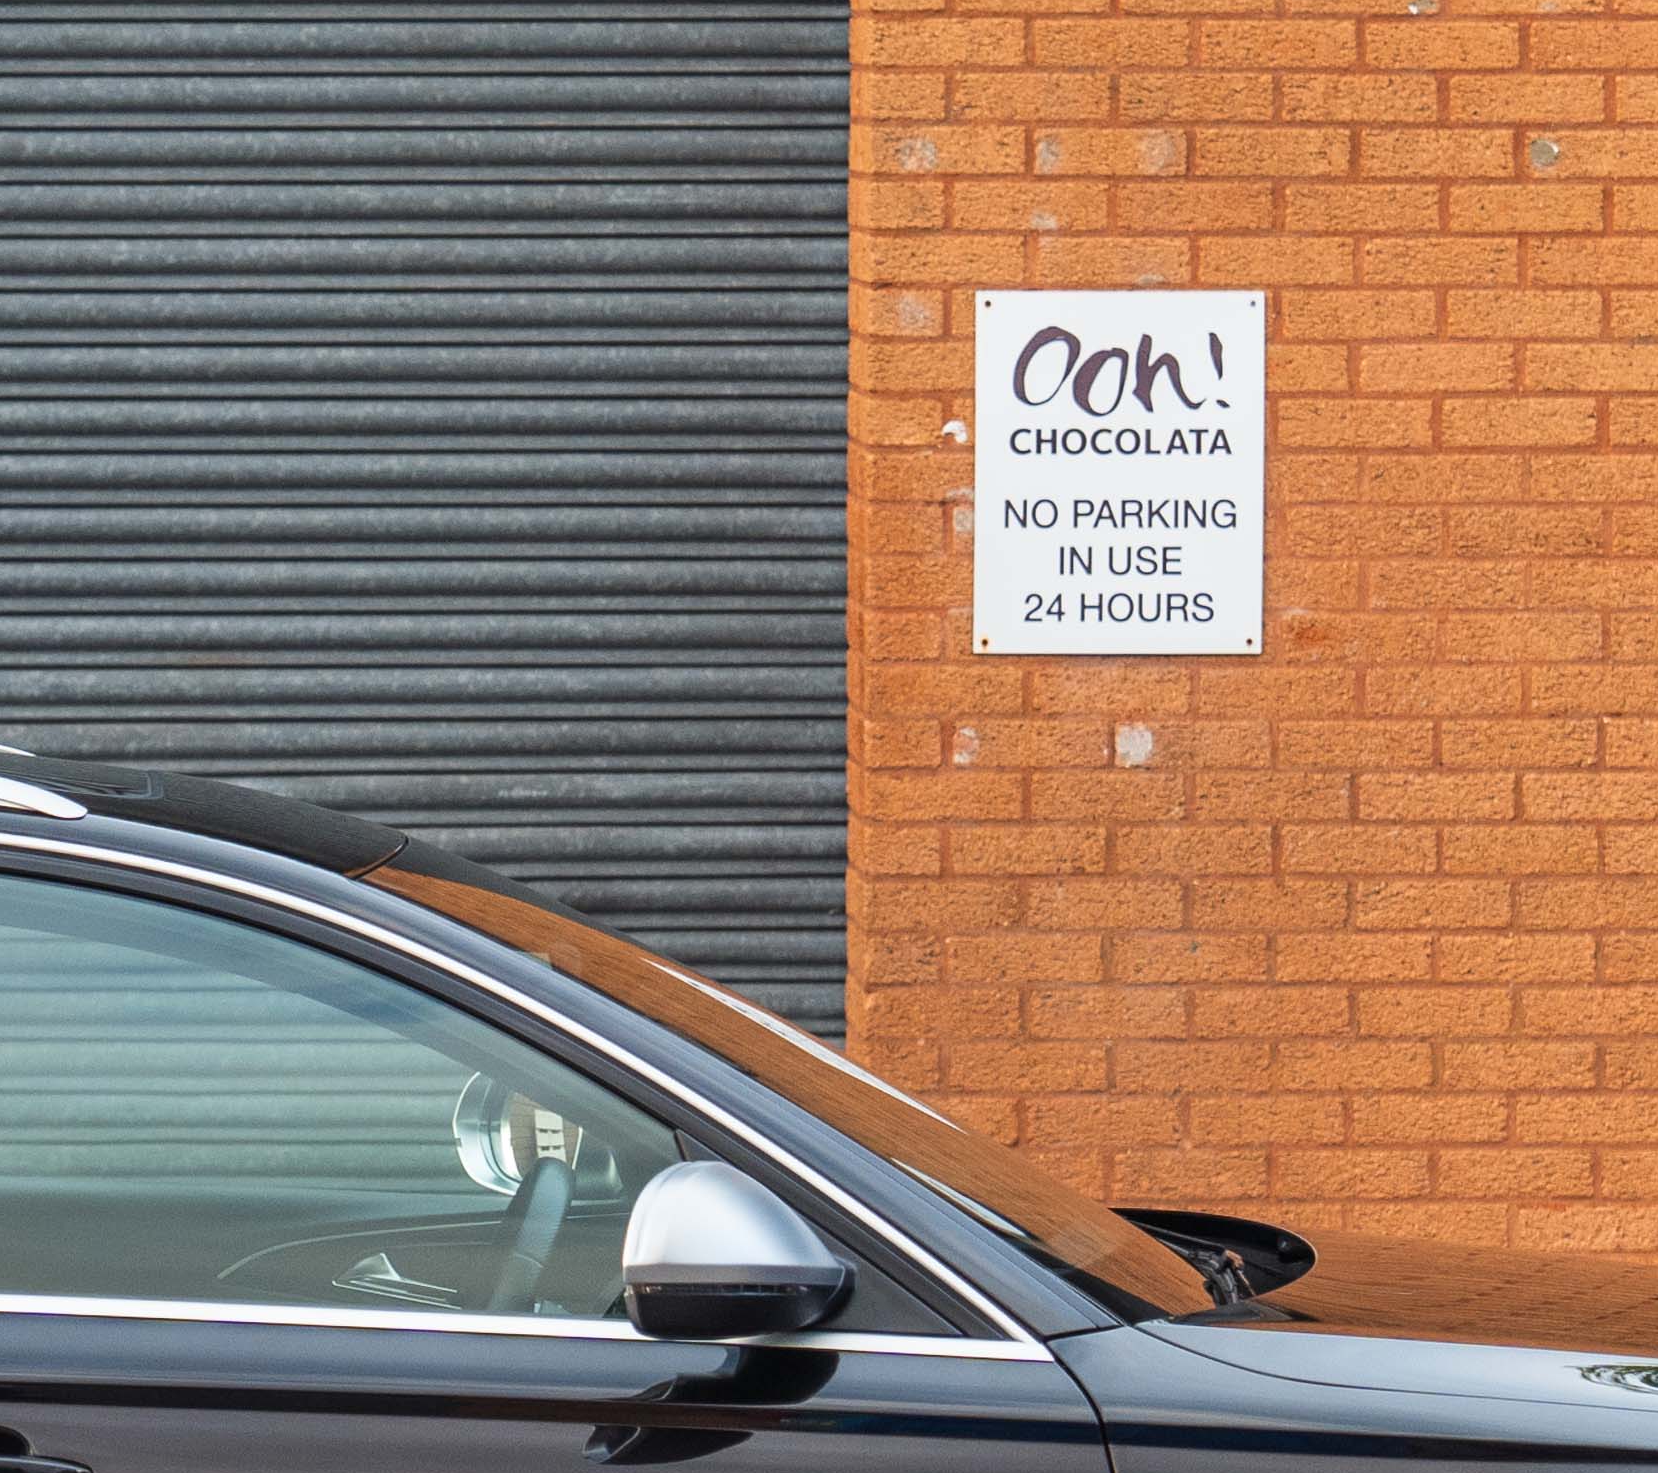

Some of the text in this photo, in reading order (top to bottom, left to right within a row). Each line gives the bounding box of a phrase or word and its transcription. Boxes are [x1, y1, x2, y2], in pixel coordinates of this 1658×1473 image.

[1012, 325, 1231, 418] Ooh!
[1009, 427, 1233, 456] CHOCOLATA
[1004, 498, 1237, 530] NO PARKING
[1059, 545, 1183, 576] IN USE
[1023, 592, 1215, 623] 24 HOURS
